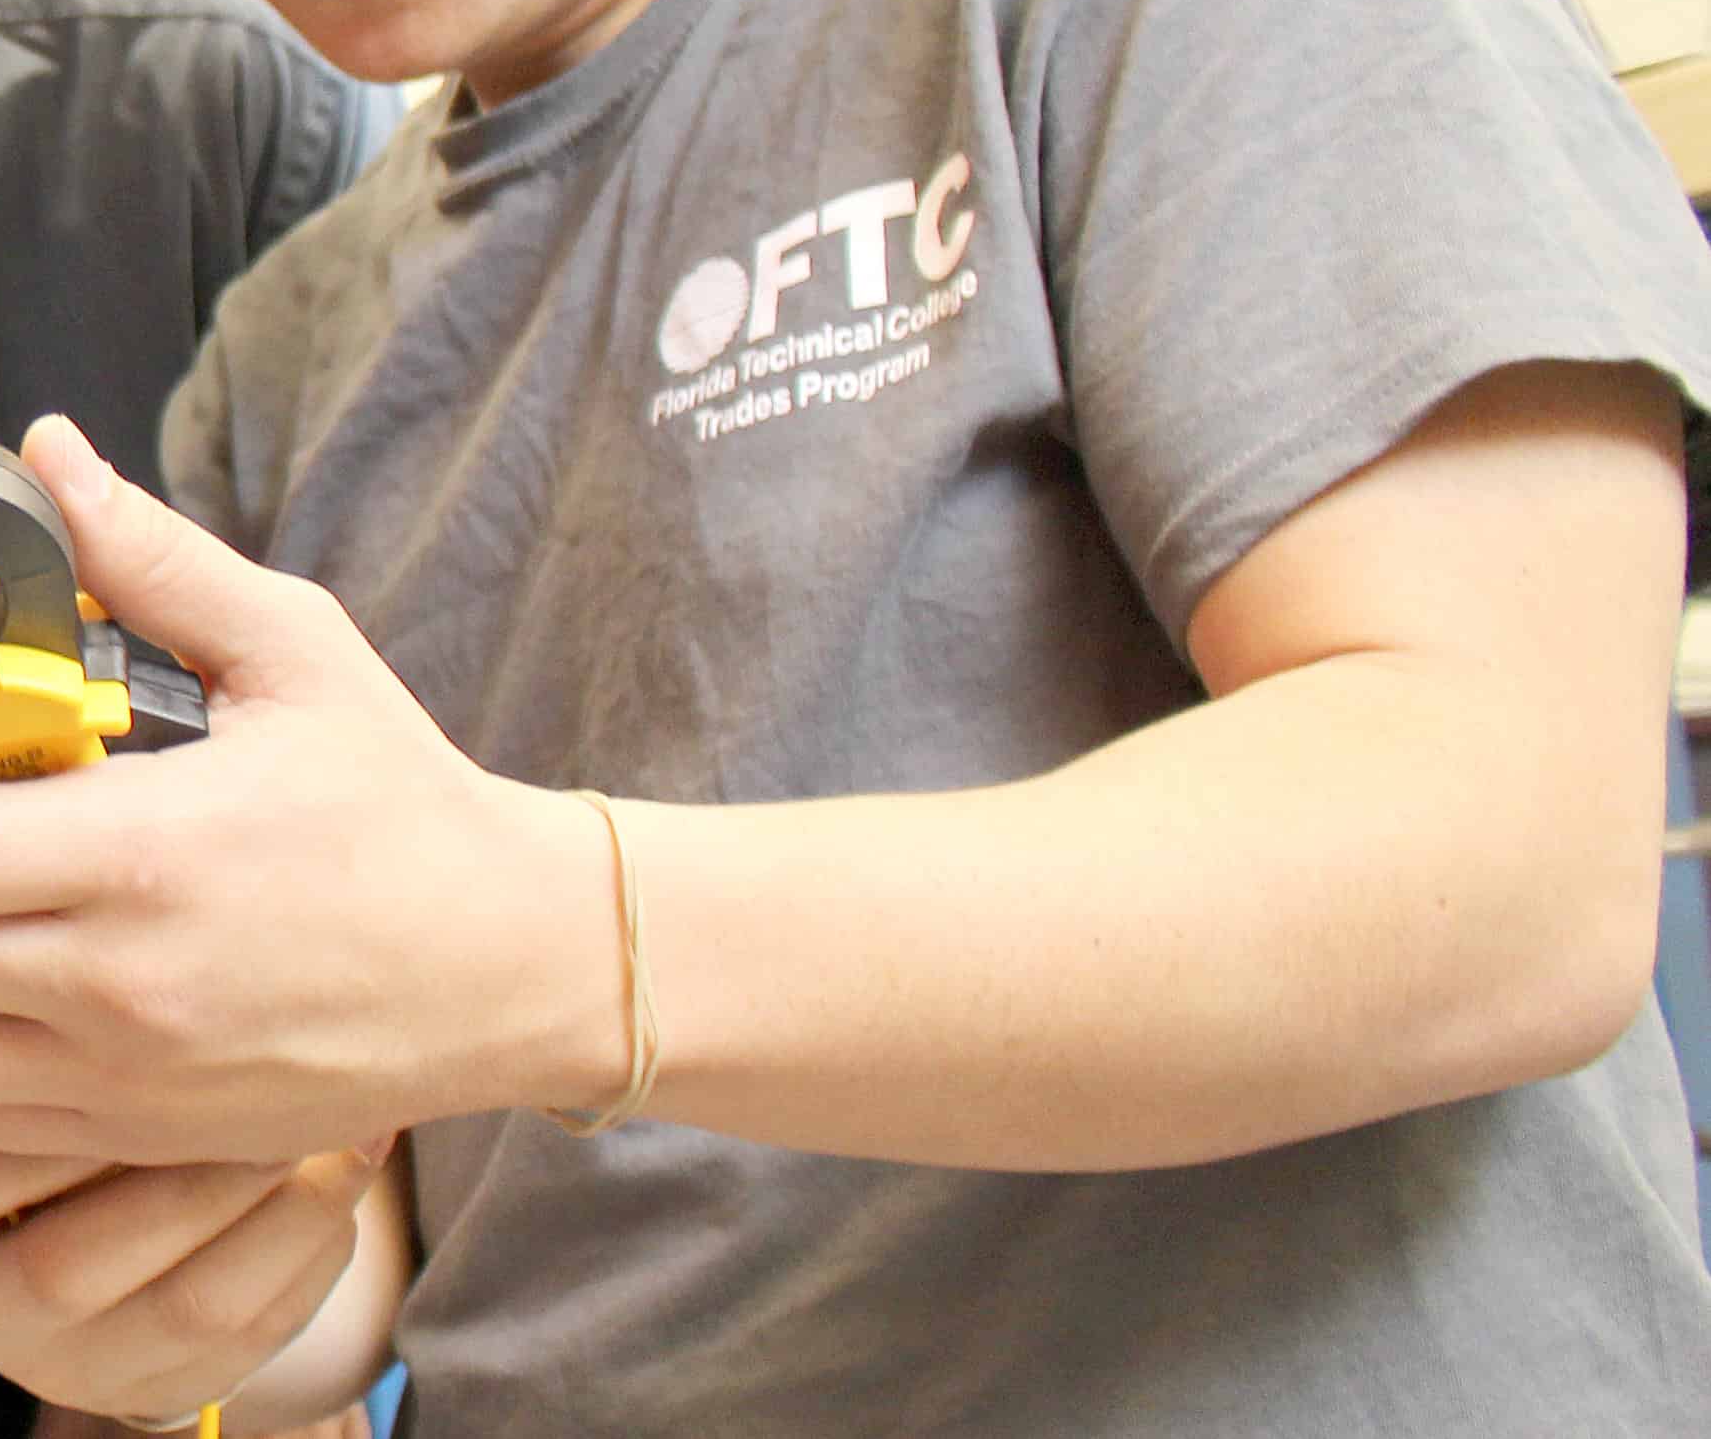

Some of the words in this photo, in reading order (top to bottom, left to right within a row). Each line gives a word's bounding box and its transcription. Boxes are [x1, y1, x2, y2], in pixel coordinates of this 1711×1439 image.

[747, 151, 975, 343] FTC
[652, 363, 738, 426] Florida
[740, 312, 884, 382] Technical
[887, 269, 978, 341] College
[695, 389, 793, 442] Trades
[796, 342, 930, 409] Program
